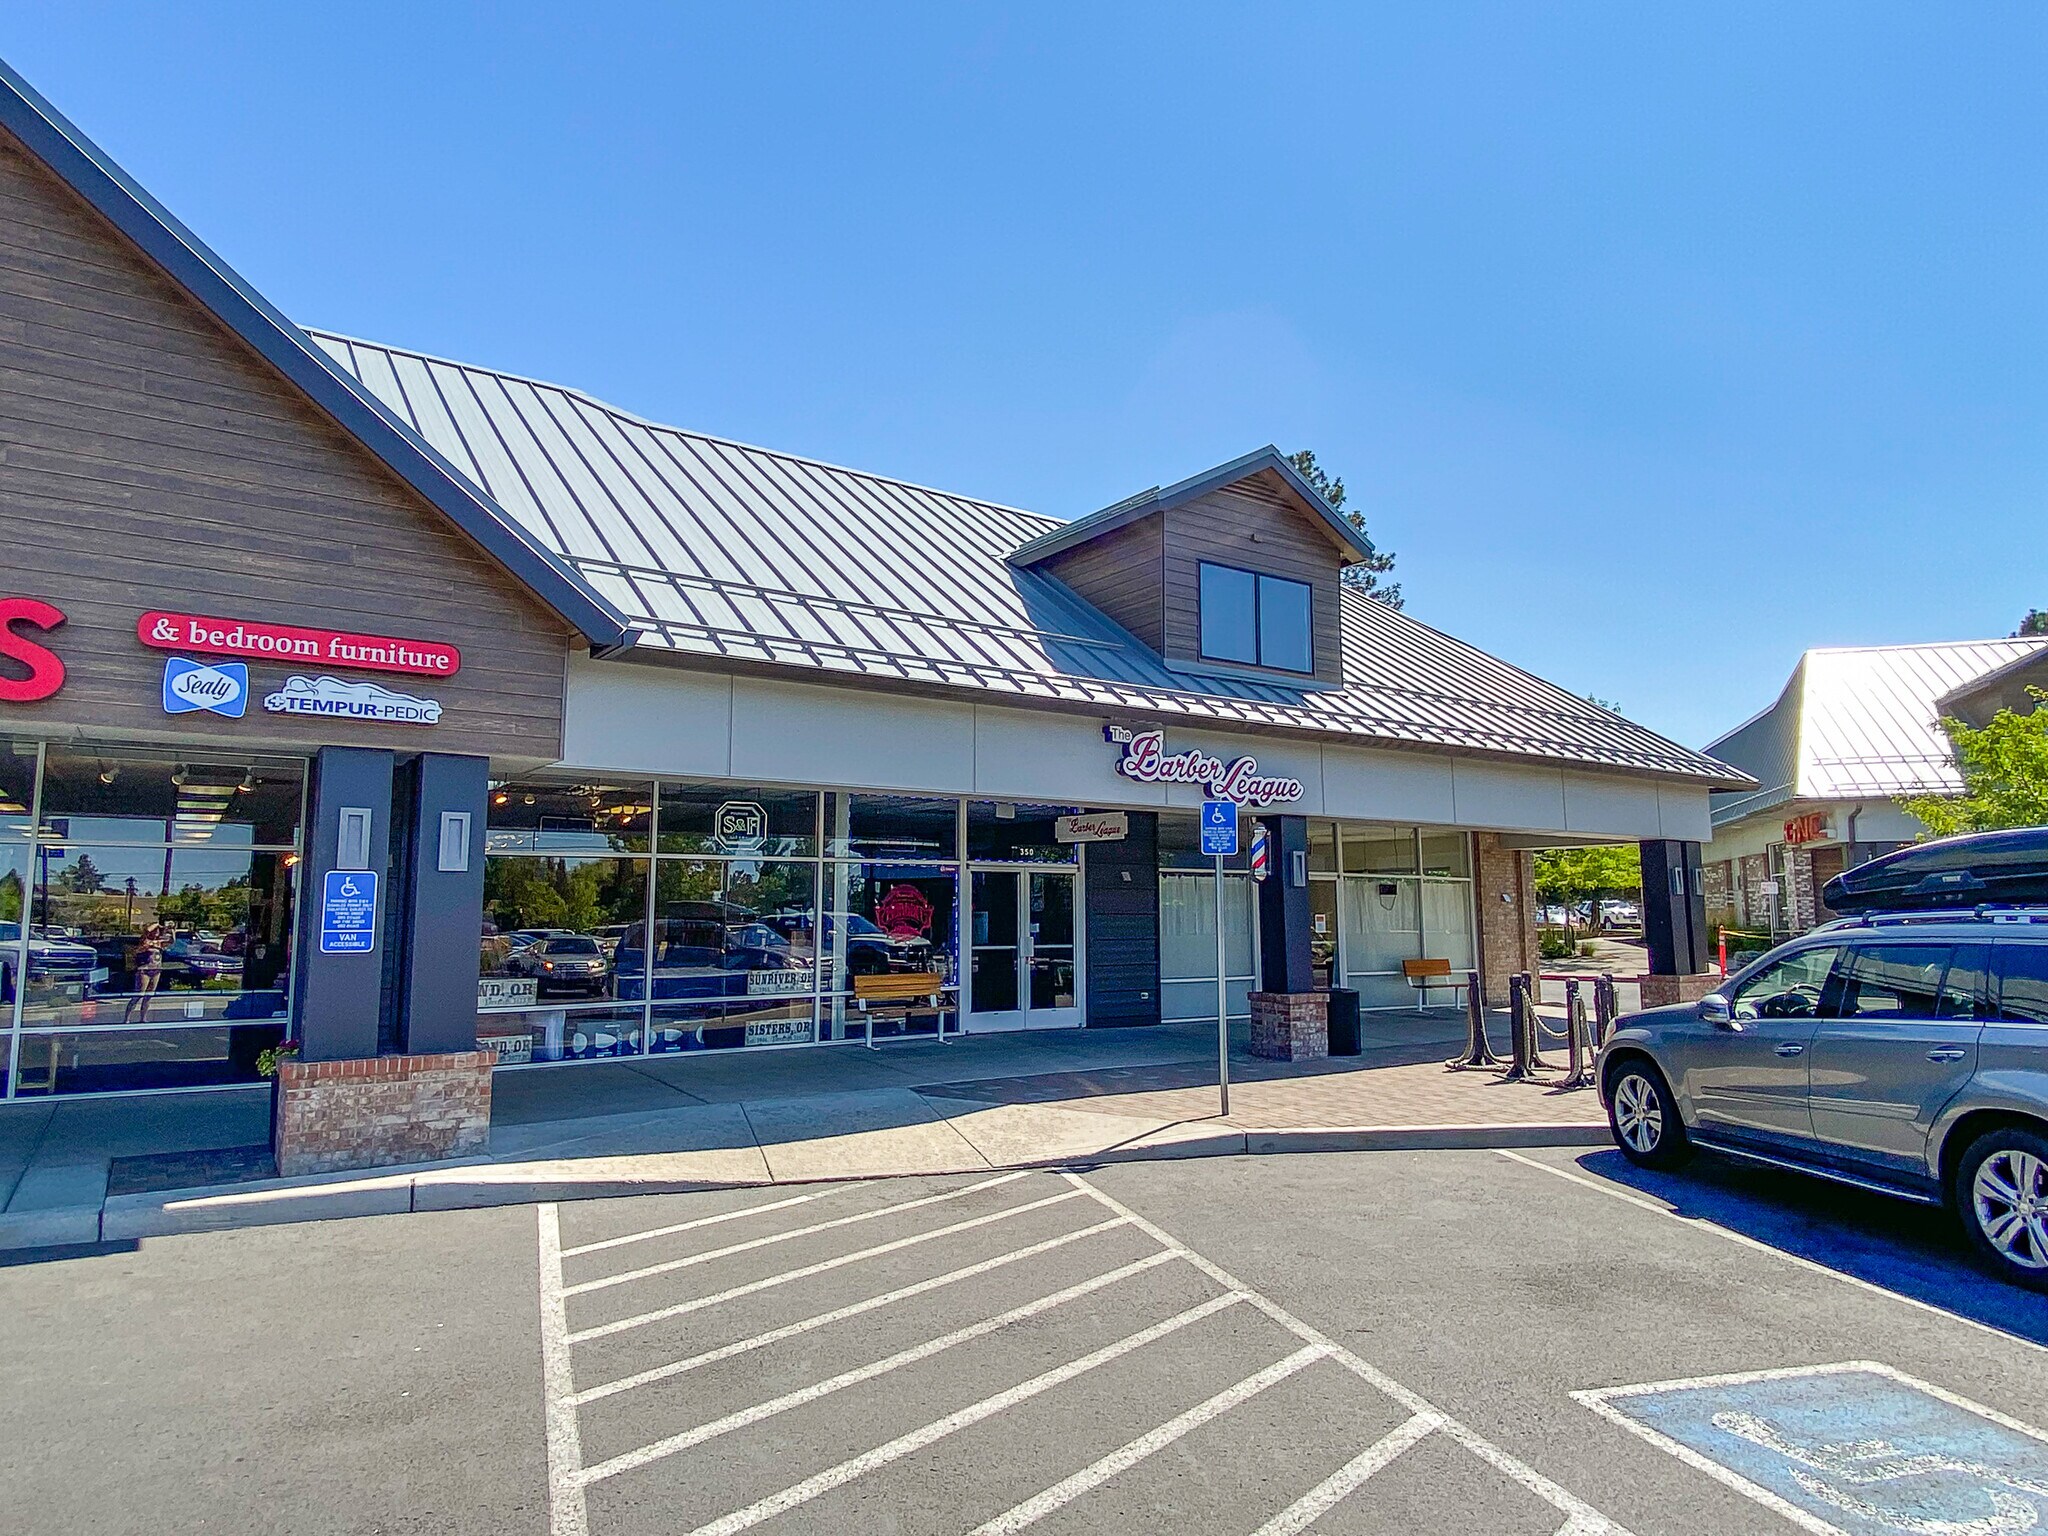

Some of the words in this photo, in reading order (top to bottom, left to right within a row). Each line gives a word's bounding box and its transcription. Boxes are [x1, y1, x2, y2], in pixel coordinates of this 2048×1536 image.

[151, 618, 180, 642] &
[189, 621, 320, 658] bedroom
[328, 637, 450, 670] furniture
[177, 674, 232, 699] Sealy
[285, 696, 437, 722] TEMPUR-PEDIC
[1112, 727, 1131, 741] The
[1126, 734, 1223, 779] Barber
[1214, 760, 1302, 802] League
[723, 815, 759, 835] S&F
[1784, 812, 1828, 844] GNC
[1020, 848, 1034, 856] 350
[339, 933, 357, 941] VAN
[510, 983, 533, 996] OR
